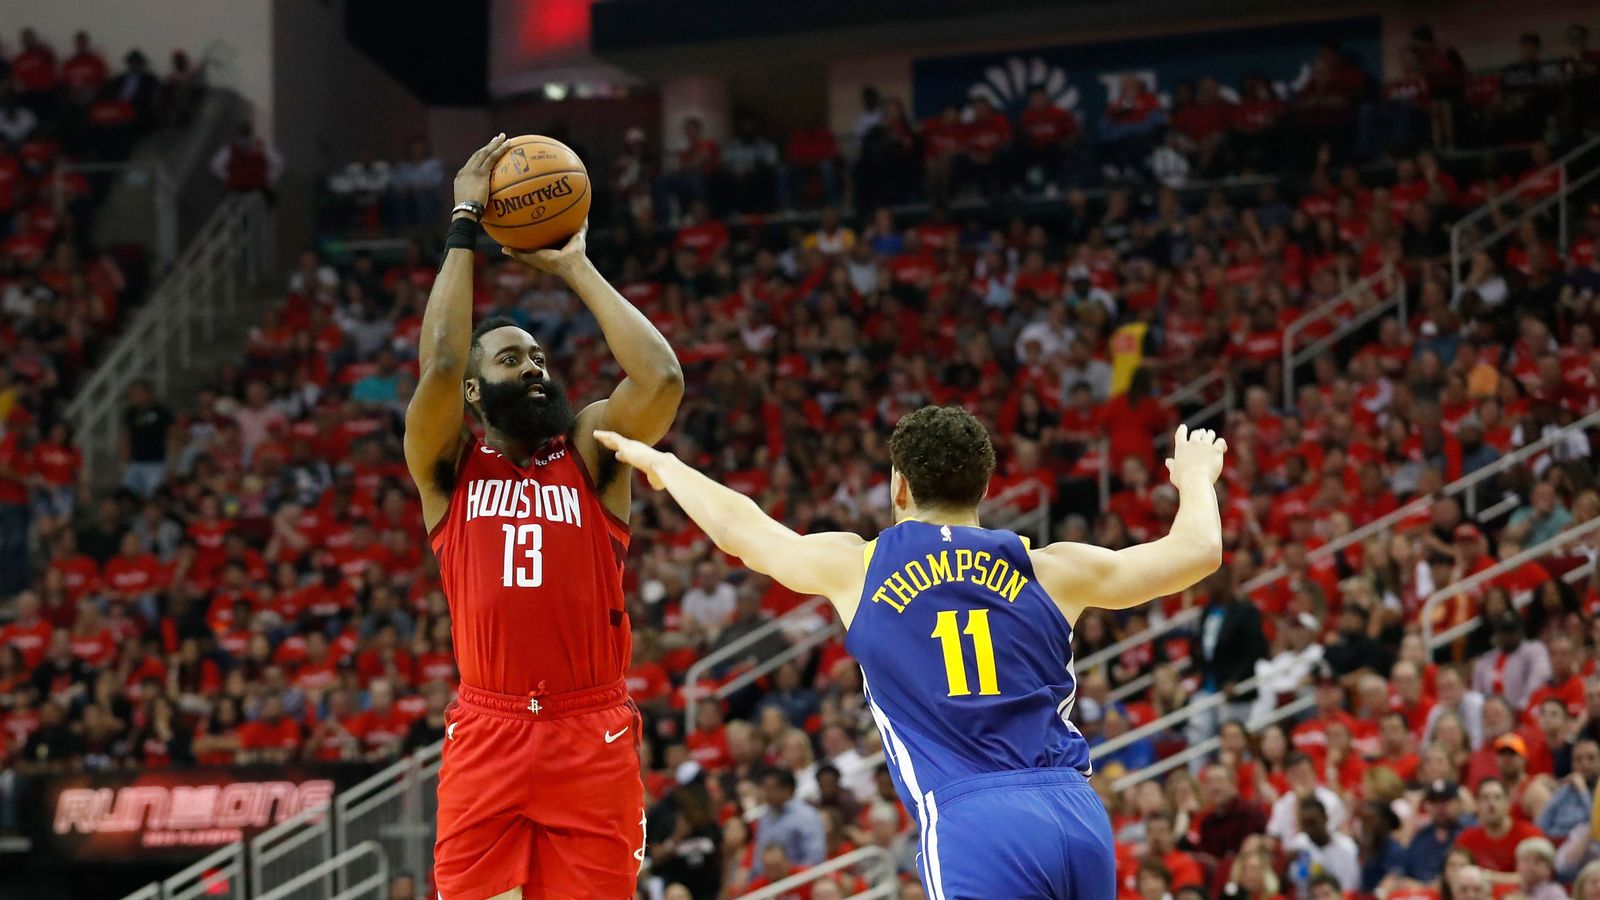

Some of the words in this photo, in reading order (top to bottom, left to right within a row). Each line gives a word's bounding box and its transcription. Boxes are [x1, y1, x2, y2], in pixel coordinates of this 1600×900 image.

[494, 176, 573, 218] SPALDING
[466, 478, 582, 528] HOUSTON
[502, 523, 543, 588] 13
[871, 549, 1029, 614] THOMPSON
[930, 608, 1002, 697] 11
